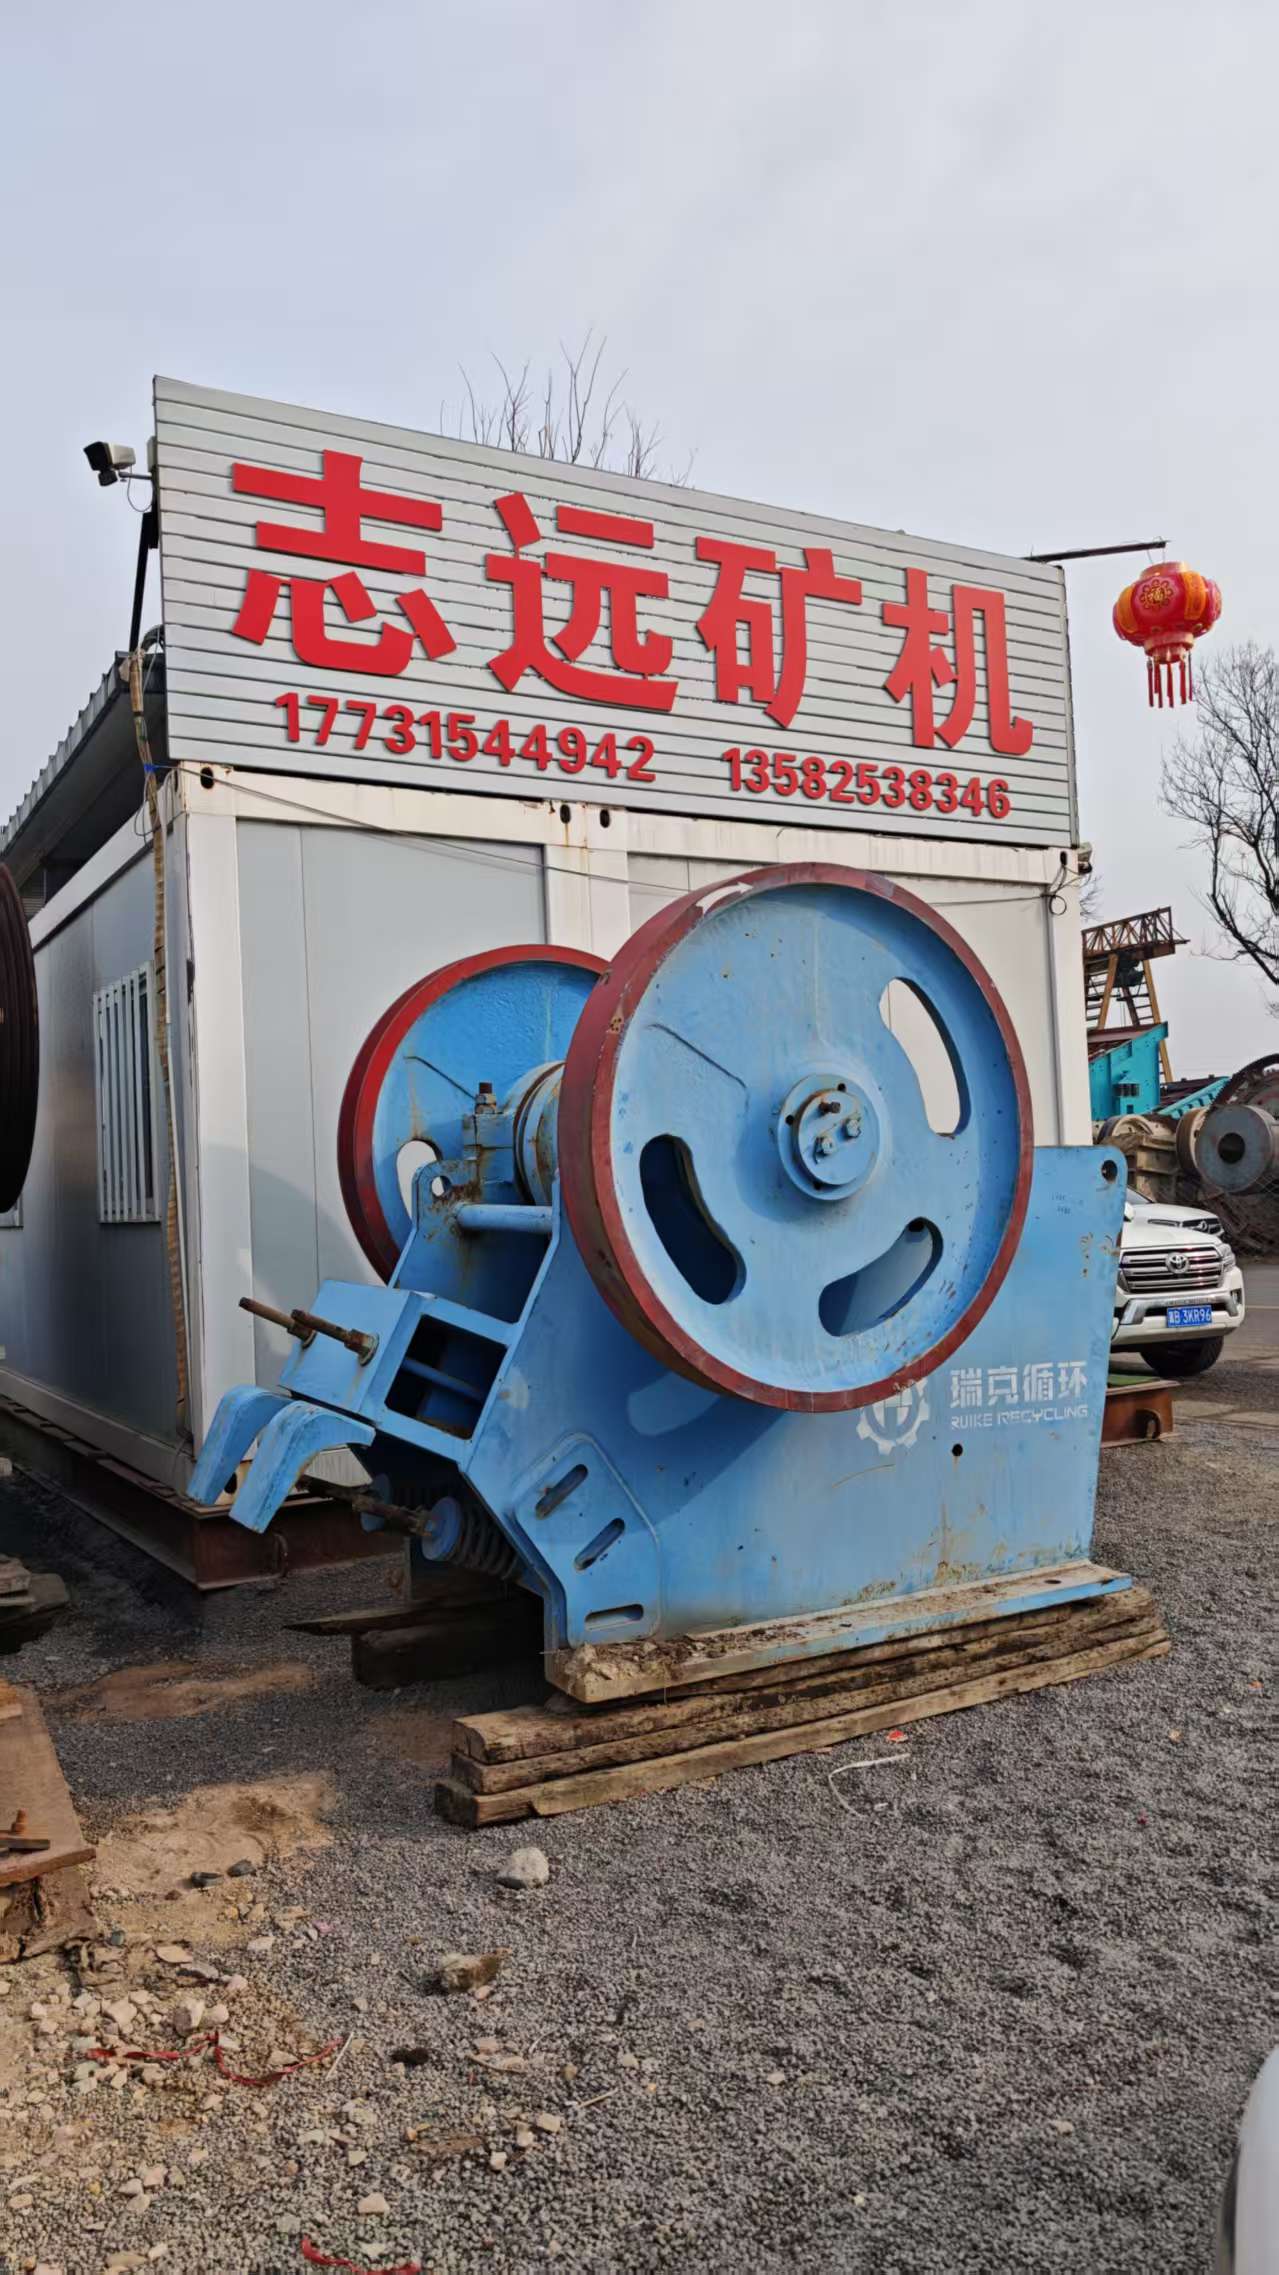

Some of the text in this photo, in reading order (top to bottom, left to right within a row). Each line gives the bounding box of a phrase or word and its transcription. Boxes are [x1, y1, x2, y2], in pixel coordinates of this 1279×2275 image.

[232, 449, 1034, 756] 志远矿机
[275, 692, 1011, 820] 17731544942 13582538346
[950, 1361, 1088, 1409] 瑞克循环
[951, 1404, 1089, 1430] RUIKE RECYCLING
